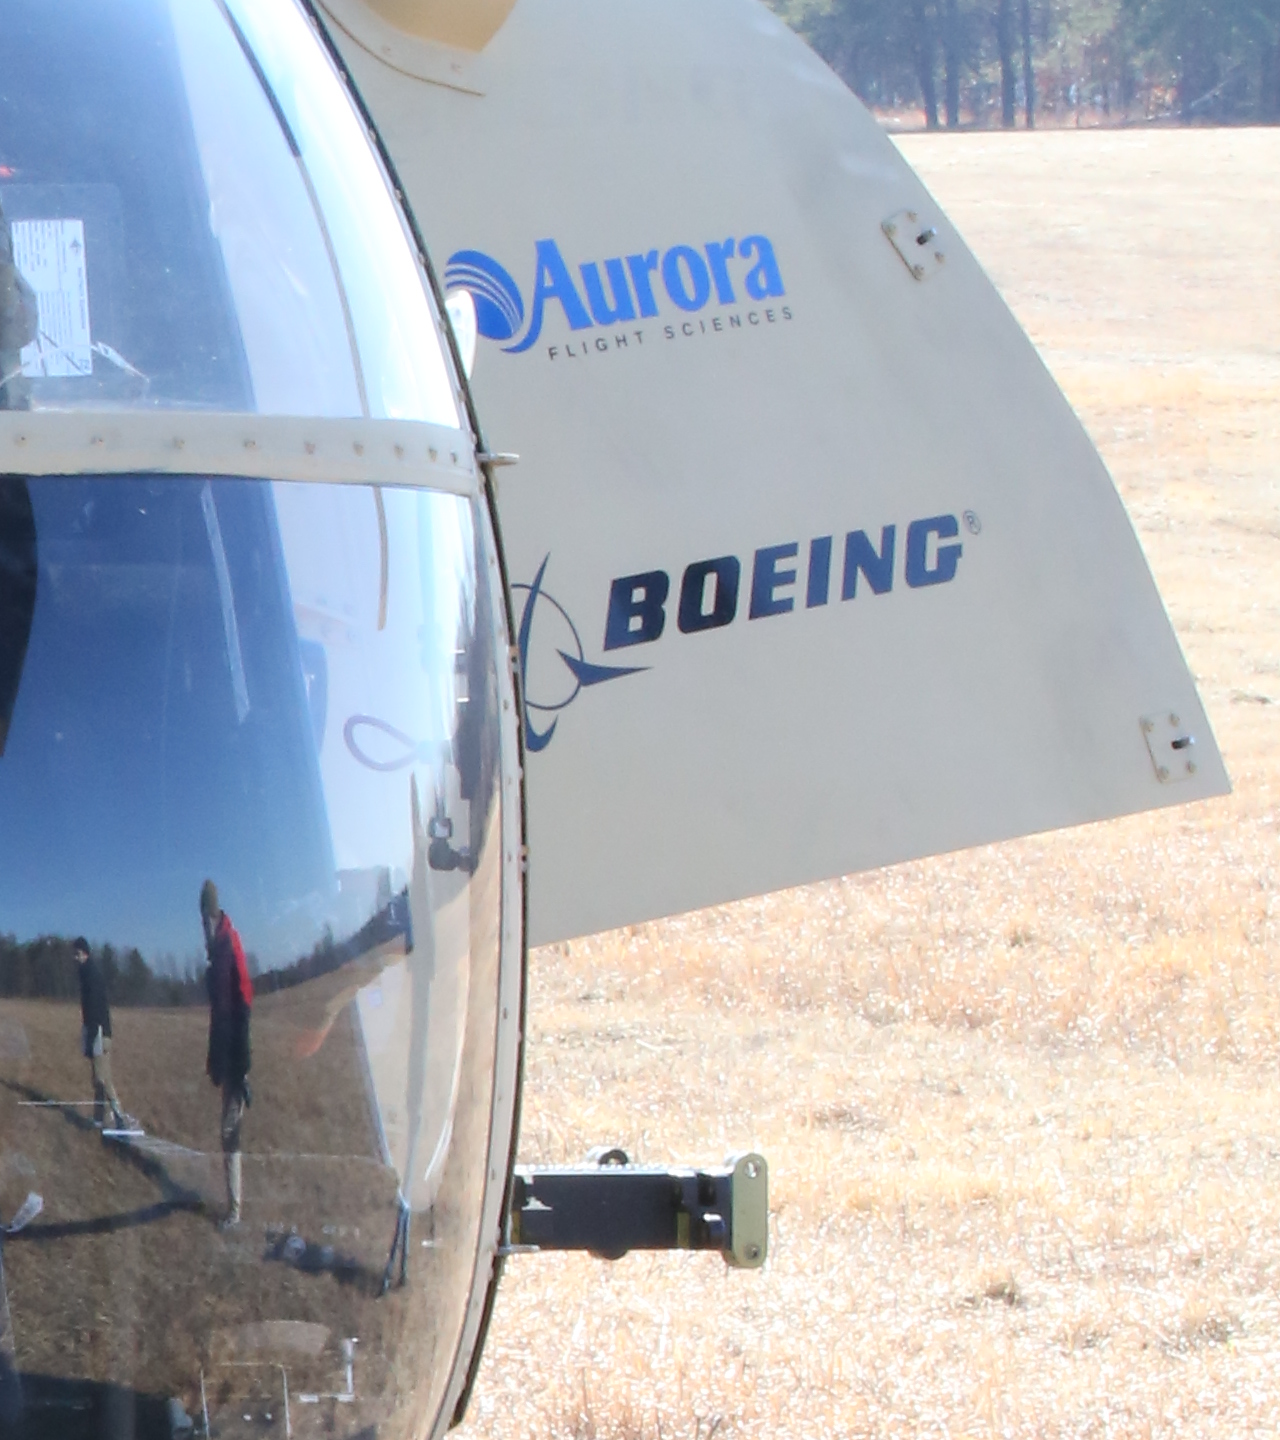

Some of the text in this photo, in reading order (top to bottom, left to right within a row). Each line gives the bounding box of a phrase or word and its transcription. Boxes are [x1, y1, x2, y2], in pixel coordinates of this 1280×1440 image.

[501, 234, 786, 352] Aurora
[547, 306, 793, 361] FLIGHT SCIENCES
